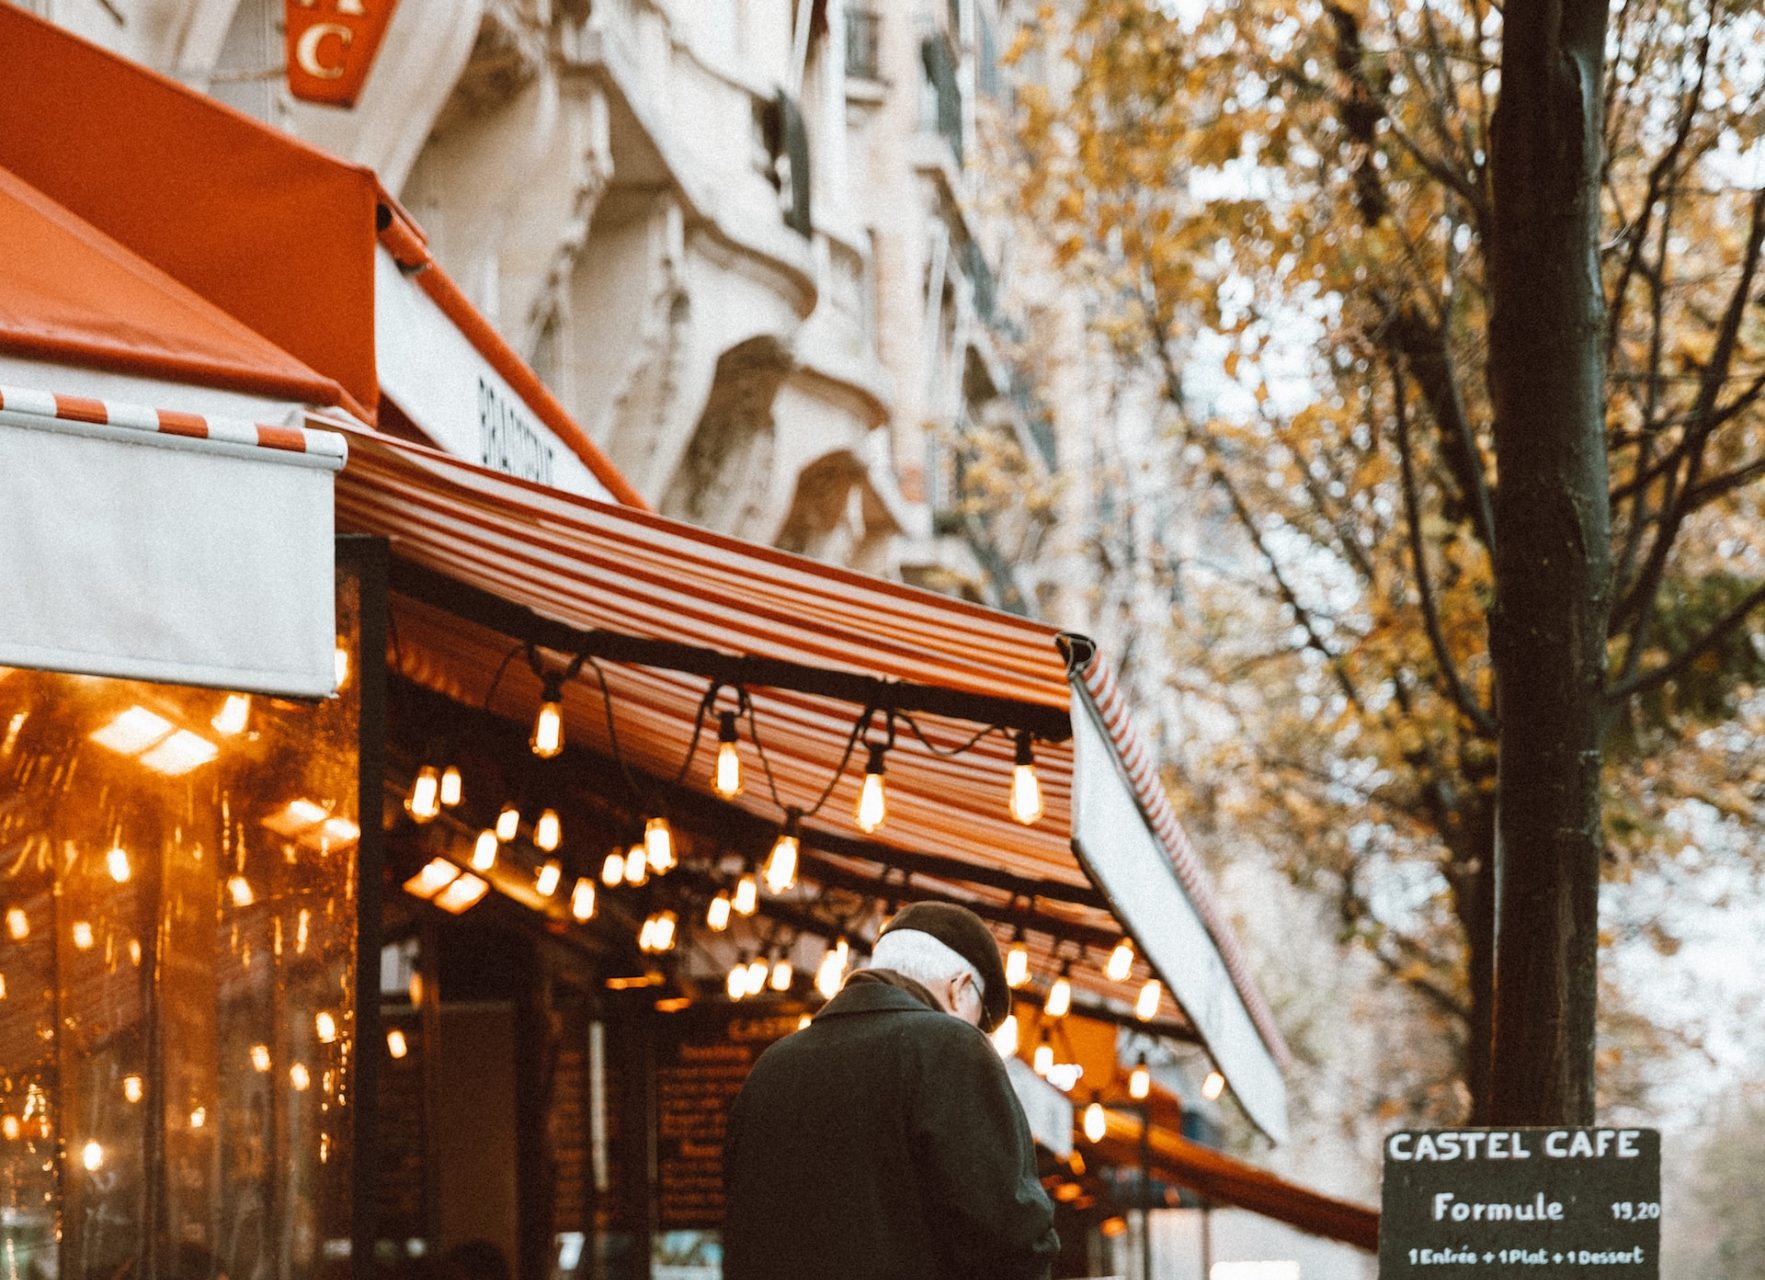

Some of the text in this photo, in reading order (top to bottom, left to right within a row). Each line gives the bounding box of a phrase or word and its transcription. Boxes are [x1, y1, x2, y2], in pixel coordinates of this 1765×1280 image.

[1388, 1130, 1641, 1161] CASTEL CAFE
[1433, 1192, 1661, 1222] Formule 19,20
